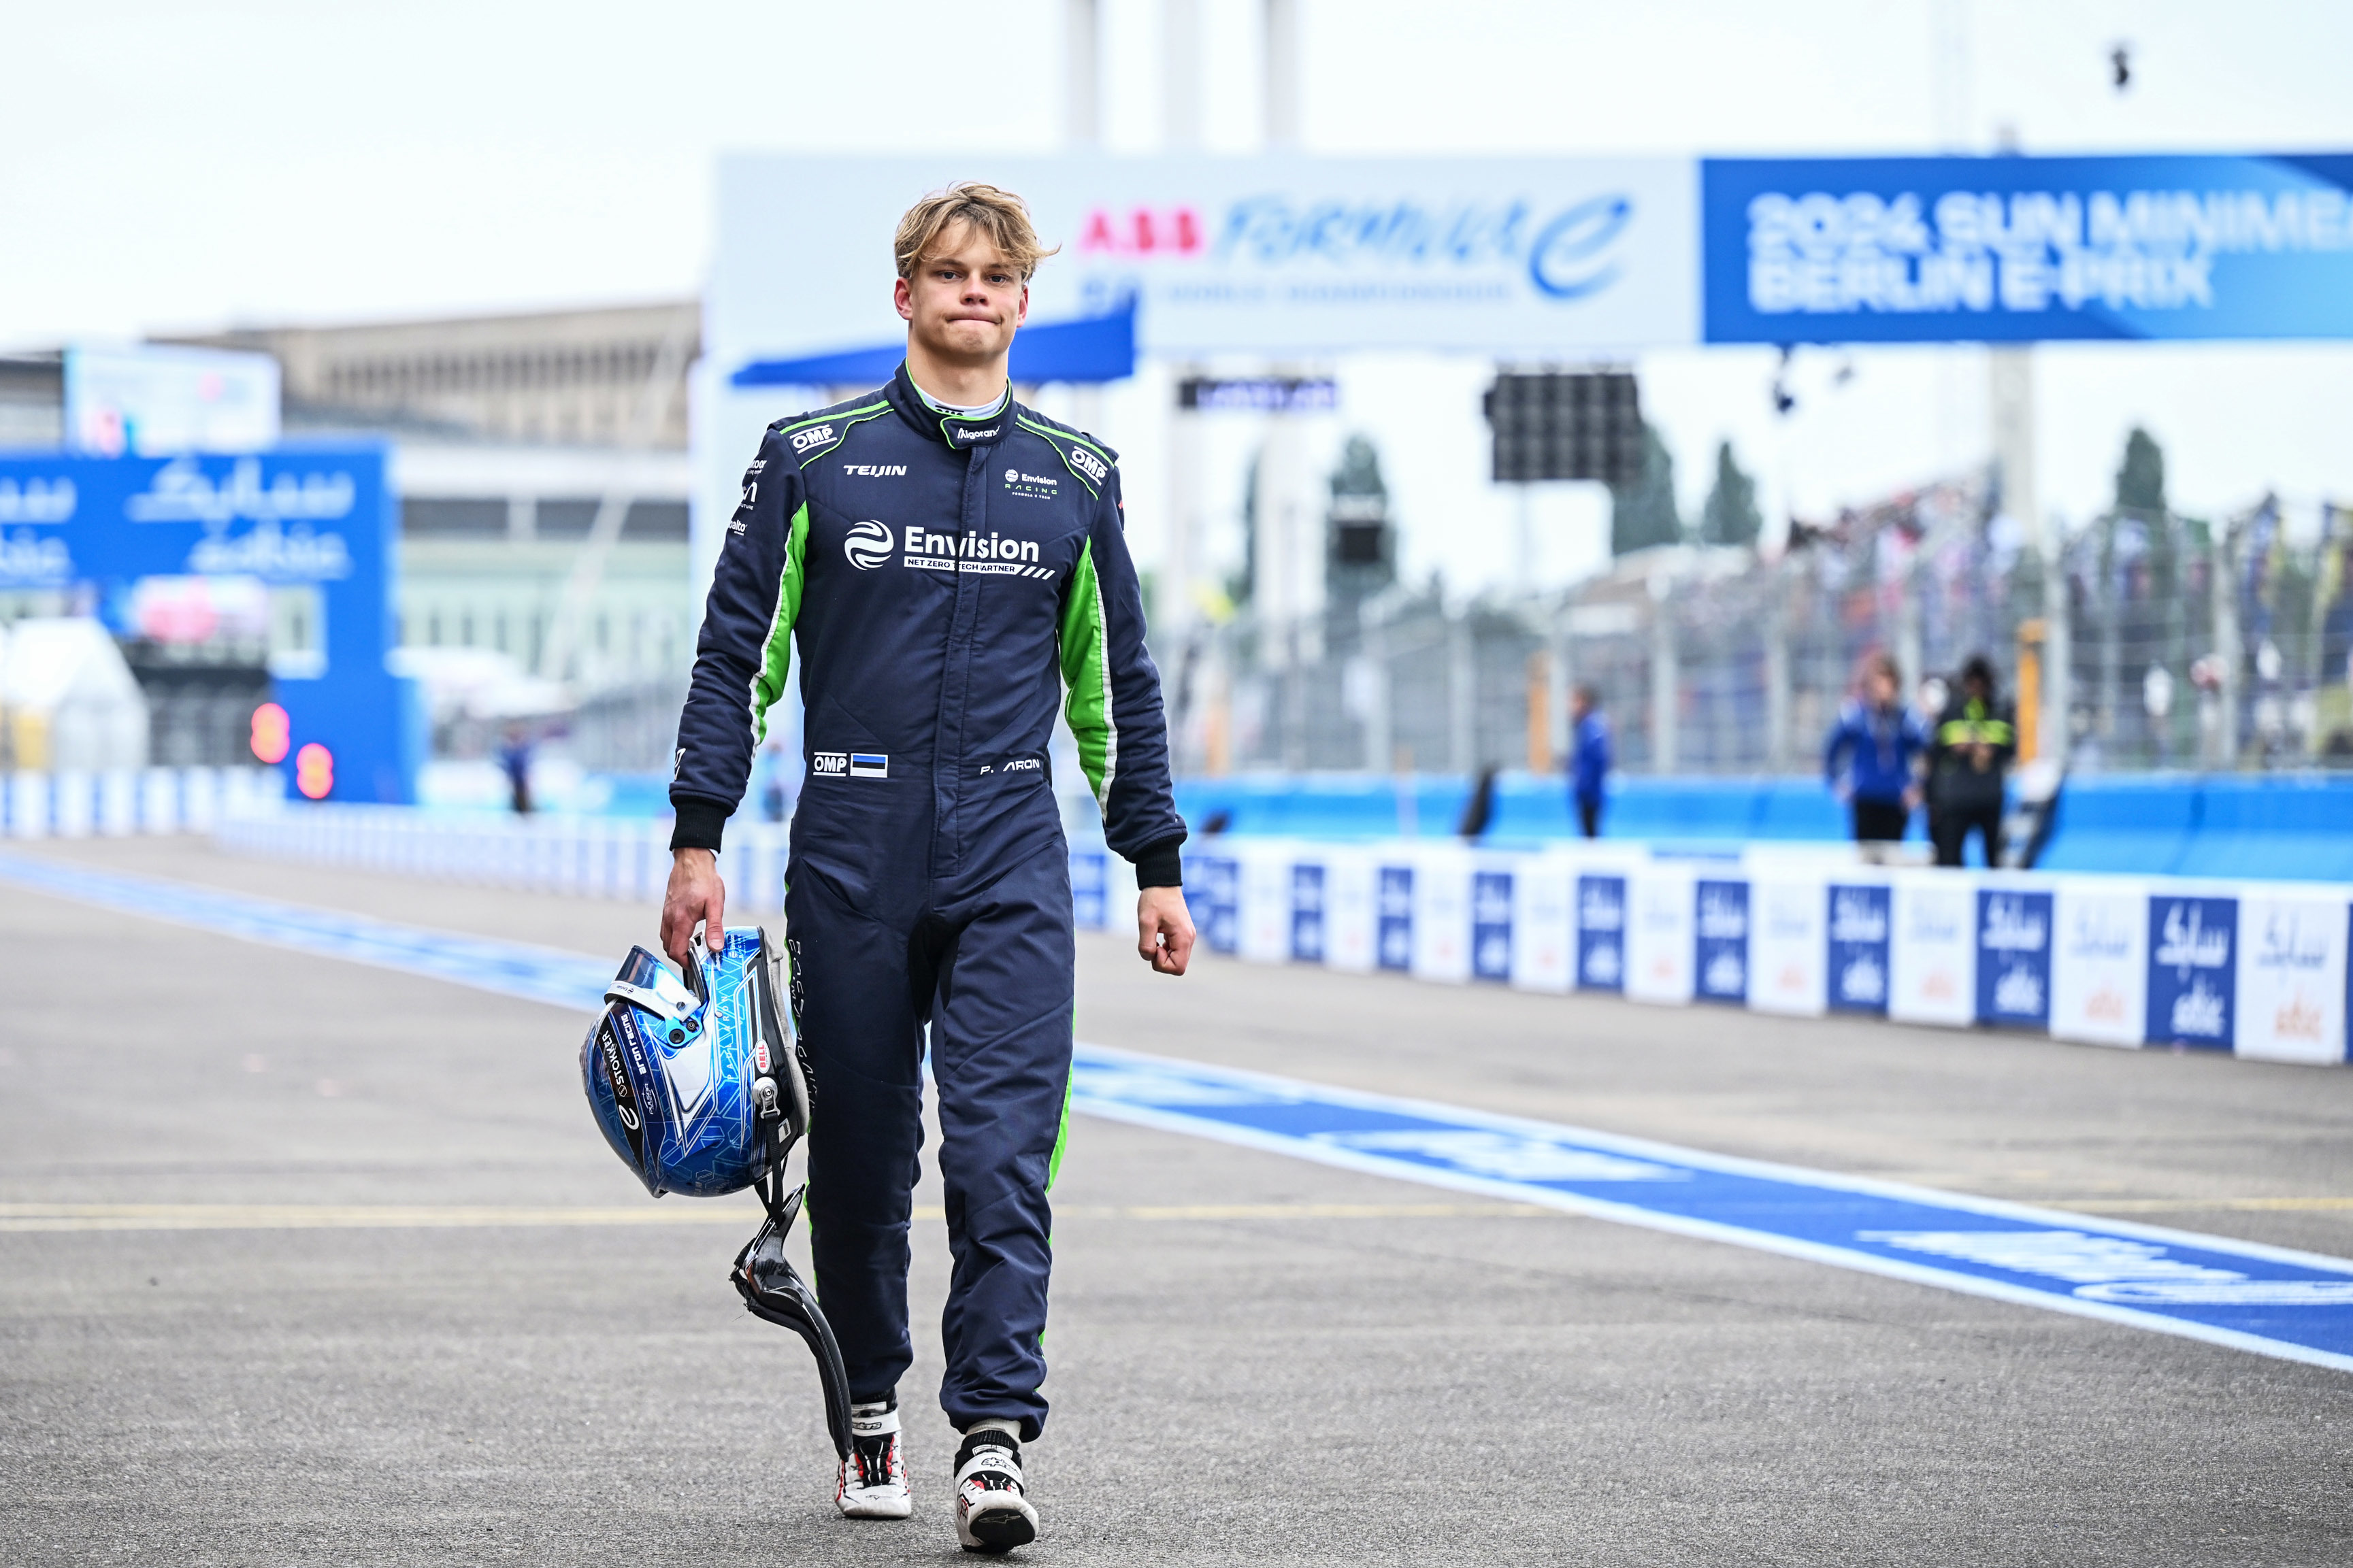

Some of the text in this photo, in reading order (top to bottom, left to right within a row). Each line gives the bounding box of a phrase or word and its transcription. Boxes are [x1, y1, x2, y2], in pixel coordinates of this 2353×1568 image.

[1081, 205, 1204, 255] ABB
[1746, 188, 2353, 253] 2024 SUN MINIME
[1747, 252, 1992, 313] BERLIN
[791, 427, 834, 450] OMP
[843, 465, 908, 478] TEIJIN
[1021, 473, 1057, 486] Envision
[1070, 448, 1107, 480] OMP
[1004, 483, 1057, 495] RACING
[904, 525, 1040, 563] Envision
[908, 558, 925, 567] NET
[927, 560, 951, 568] ZERO
[980, 564, 1015, 572] ARTNER
[814, 755, 847, 773] OMP
[980, 758, 1040, 775] P. ARON
[620, 1014, 647, 1075] aron racing
[721, 996, 734, 1080] PAUL ARON
[601, 1029, 625, 1085] STOKKER
[758, 1044, 767, 1069] BELL
[644, 1082, 655, 1115] PULSAR
